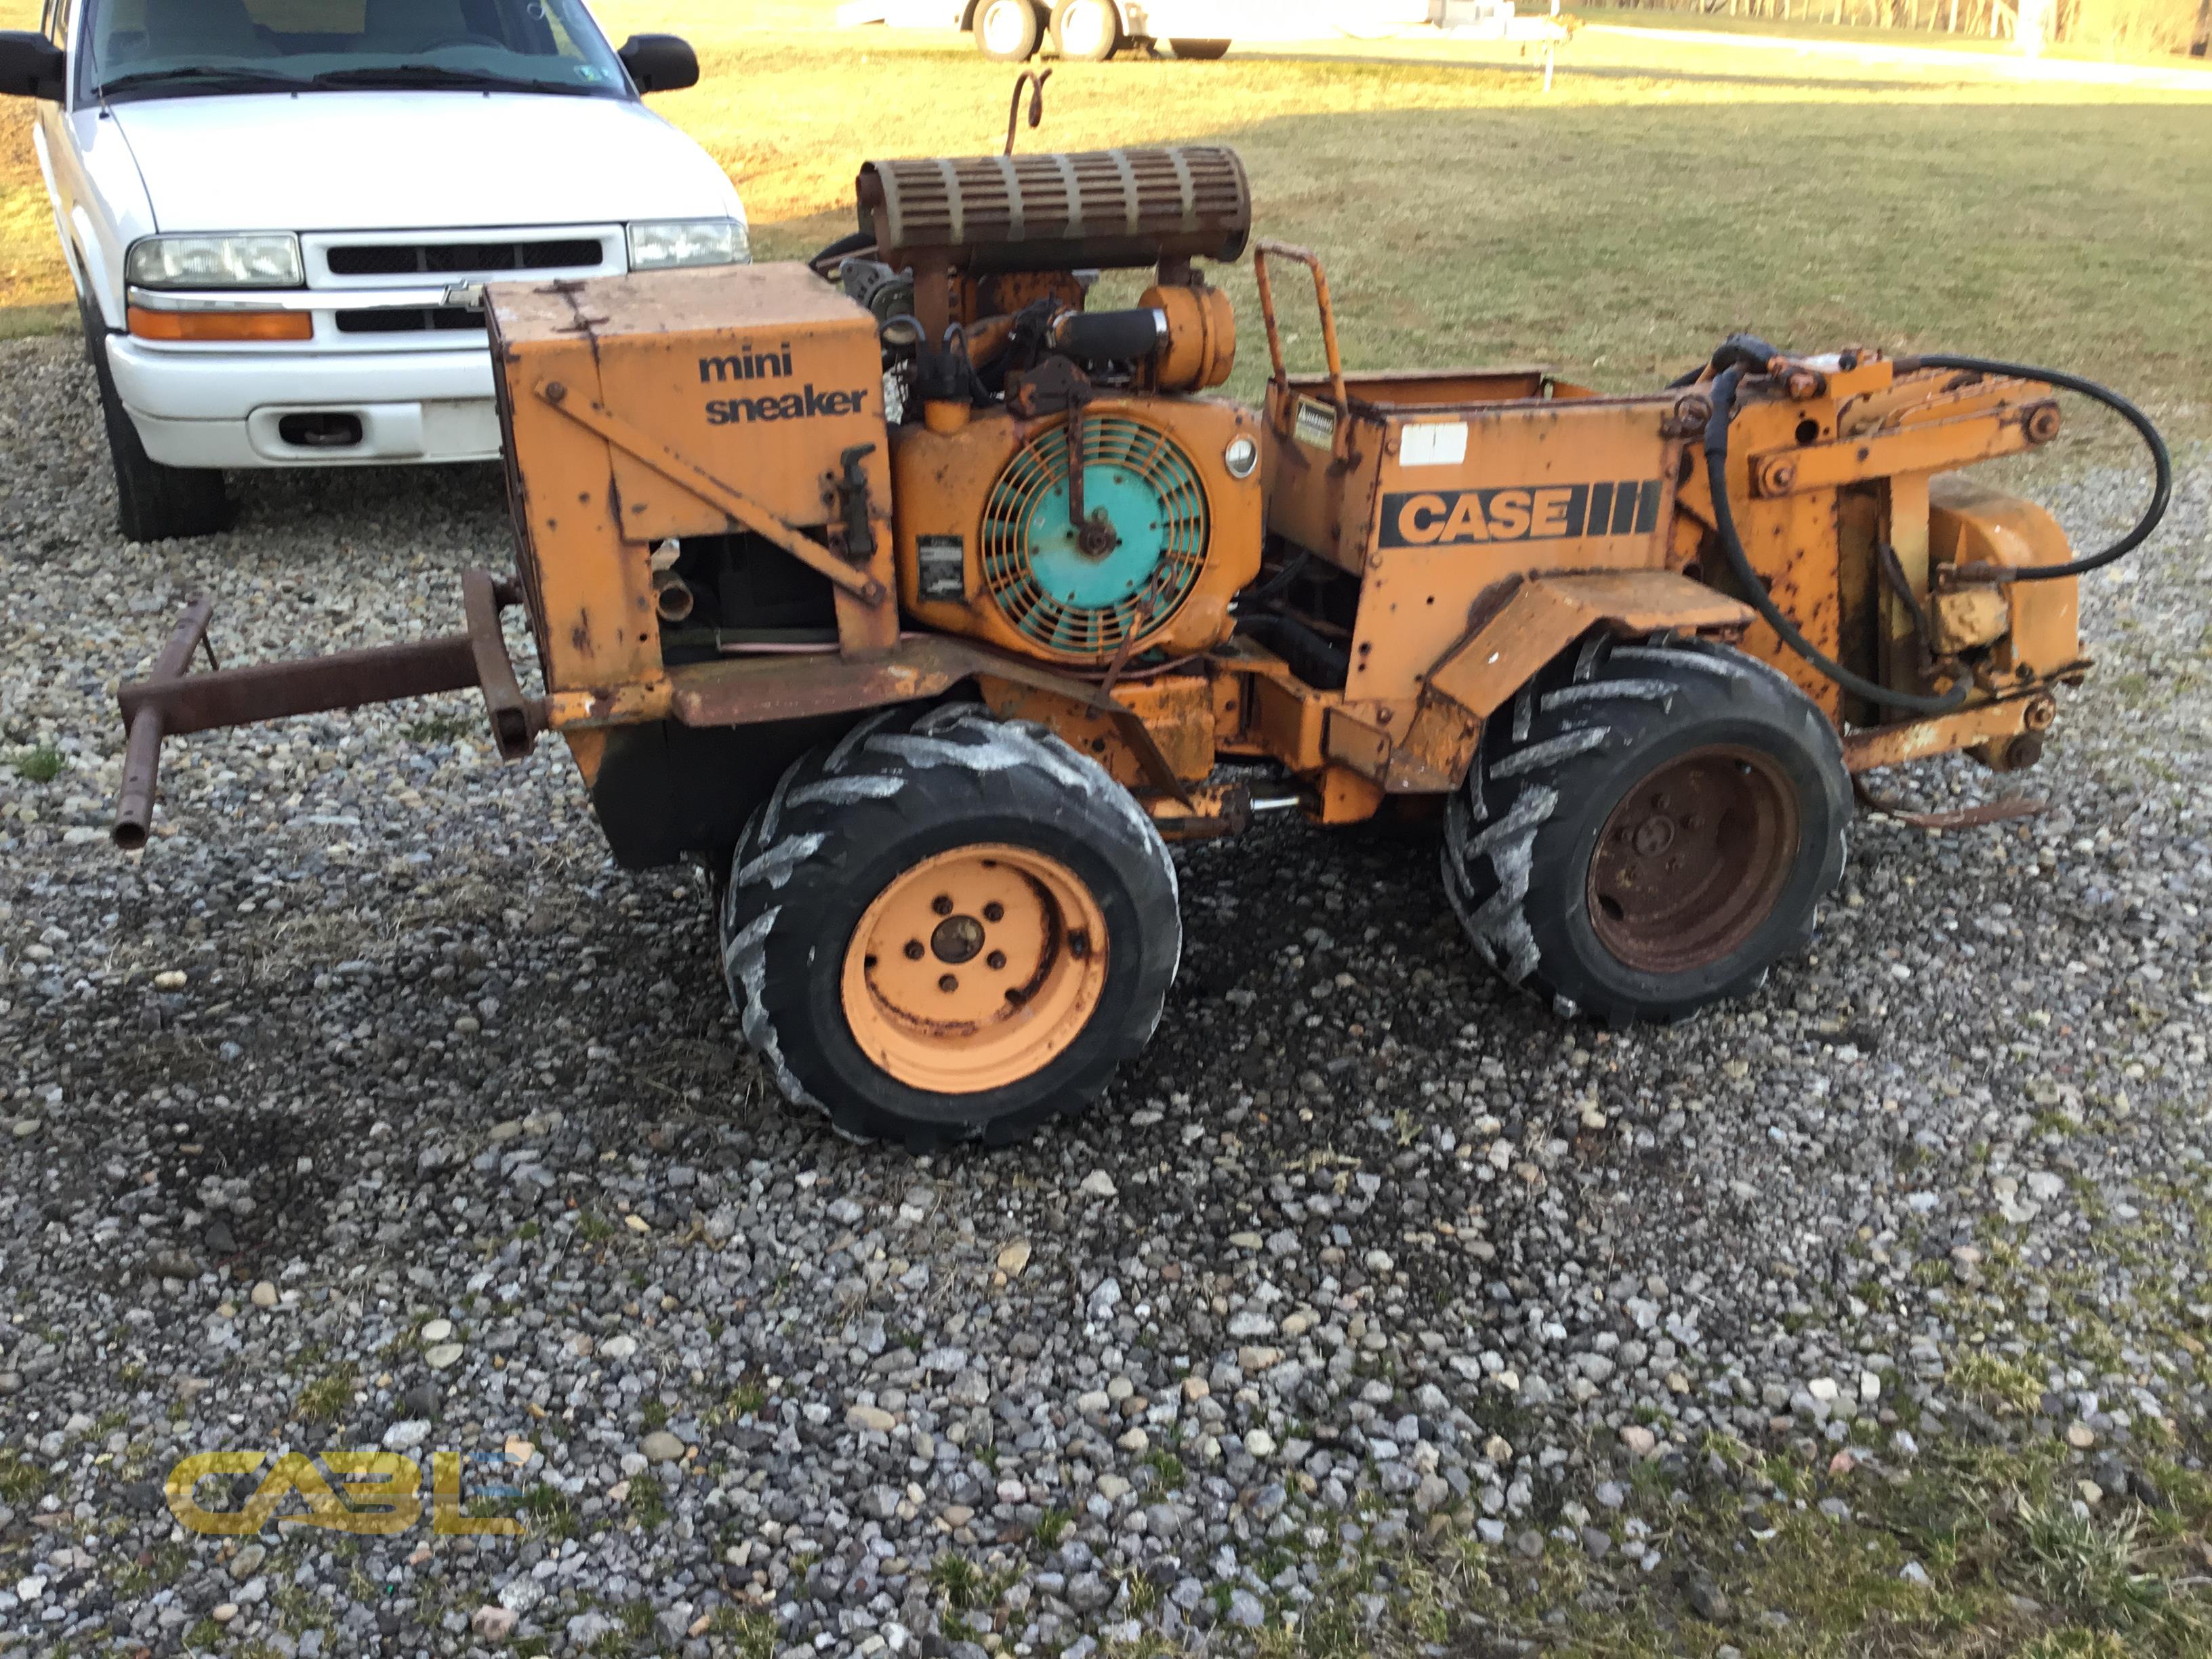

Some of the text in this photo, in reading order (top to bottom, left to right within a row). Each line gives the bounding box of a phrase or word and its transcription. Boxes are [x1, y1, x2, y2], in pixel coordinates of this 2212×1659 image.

[699, 341, 792, 384] mini
[705, 384, 867, 426] sneaker
[1398, 488, 1572, 544] CASE
